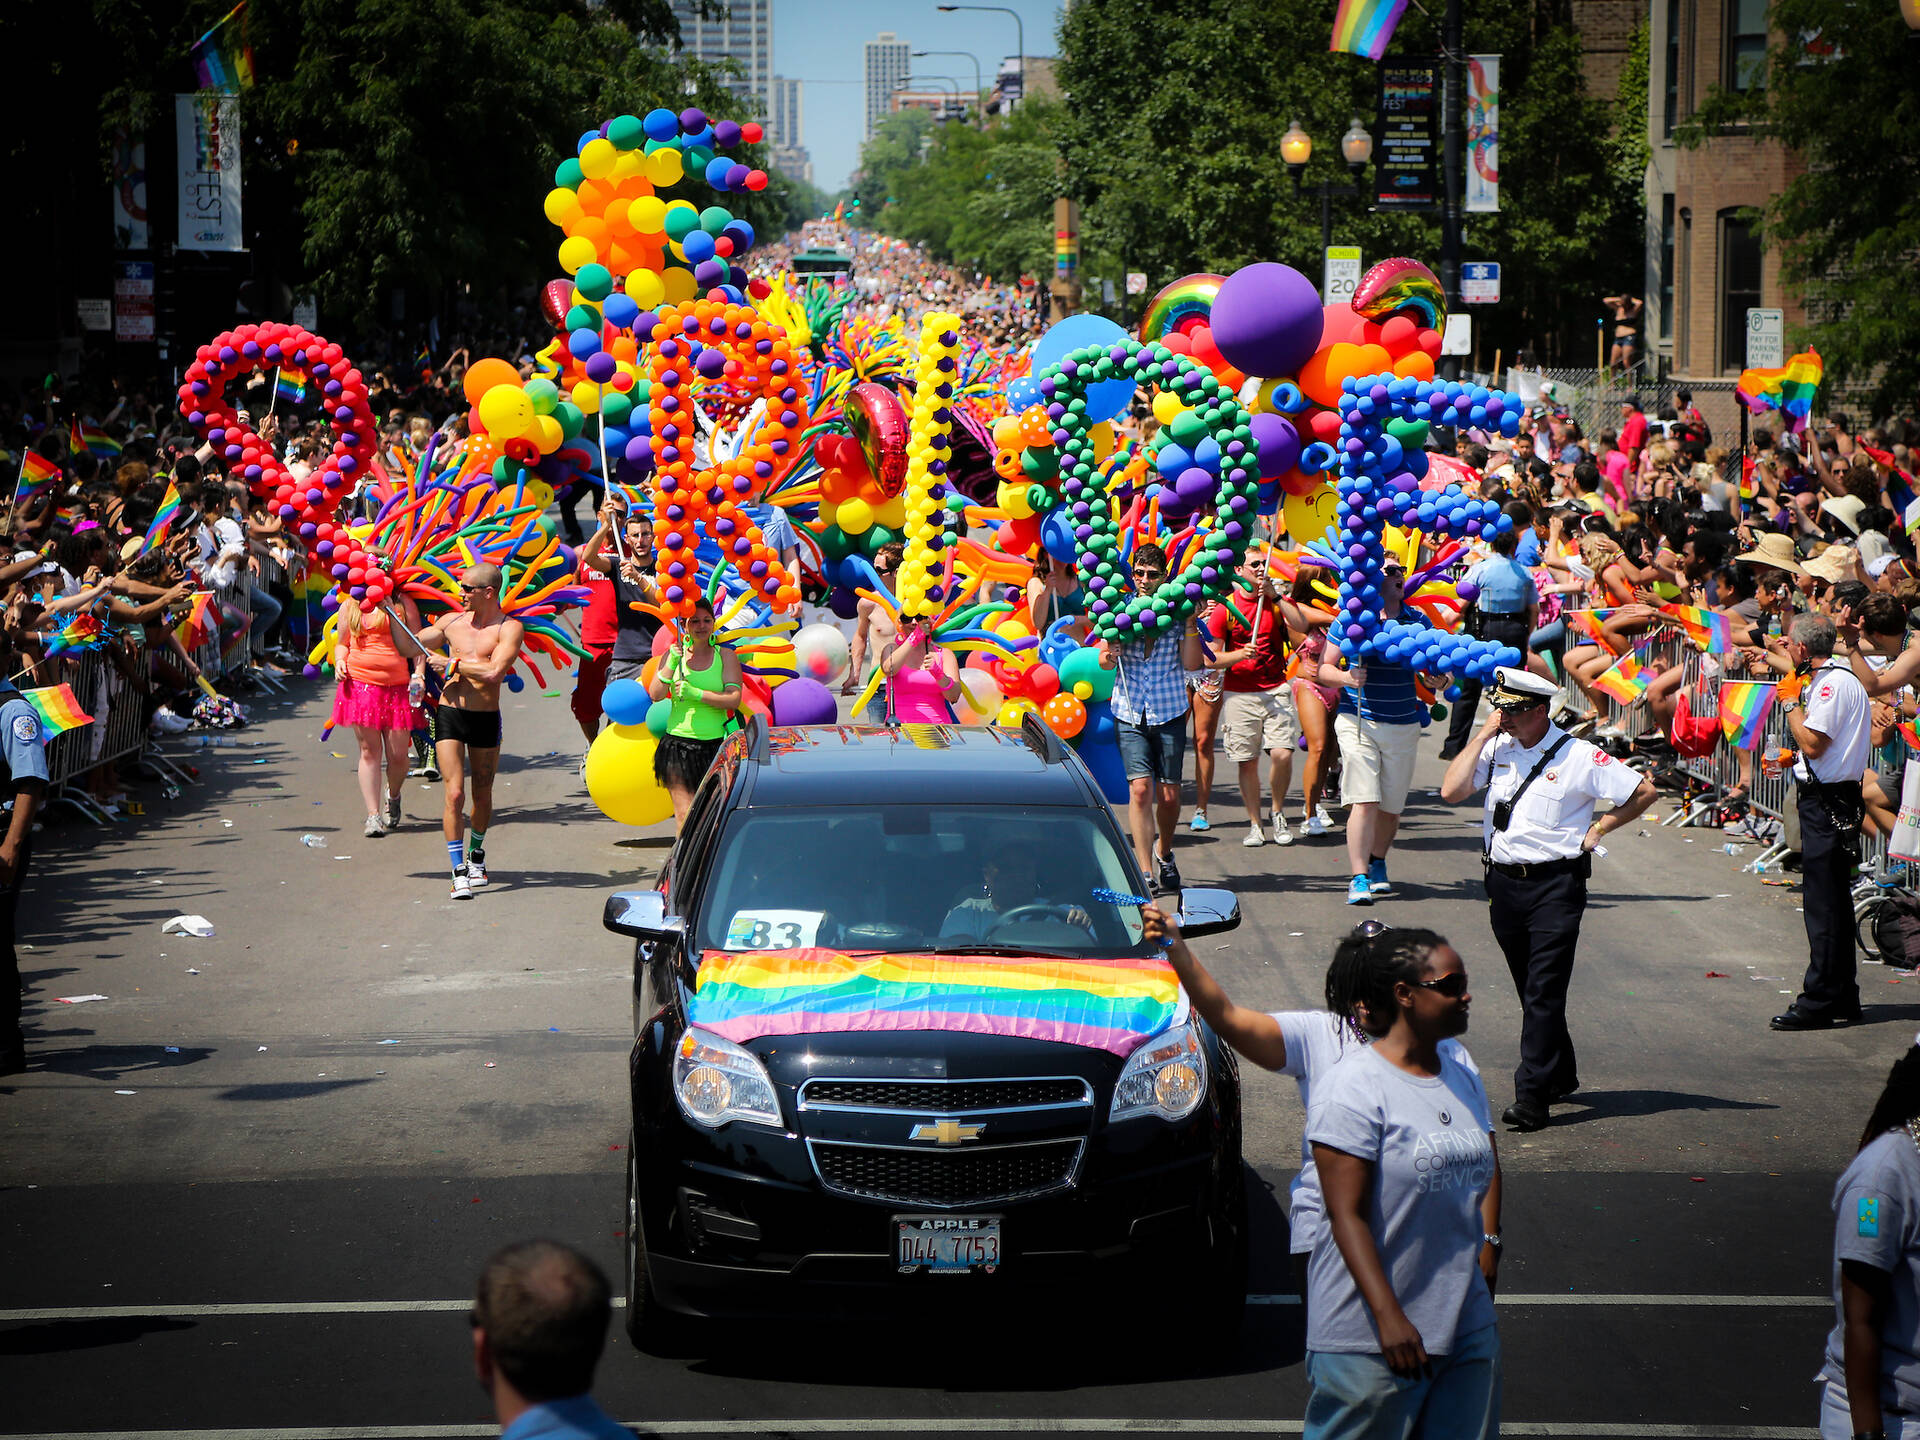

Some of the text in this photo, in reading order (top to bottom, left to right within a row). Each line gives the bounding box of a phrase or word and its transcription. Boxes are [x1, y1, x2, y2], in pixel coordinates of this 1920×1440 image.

[1331, 279, 1356, 294] 20
[743, 920, 802, 948] 83
[1413, 1127, 1489, 1157] AFFINIT
[920, 1220, 979, 1230] APPLE
[901, 1236, 998, 1263] D44 7753
